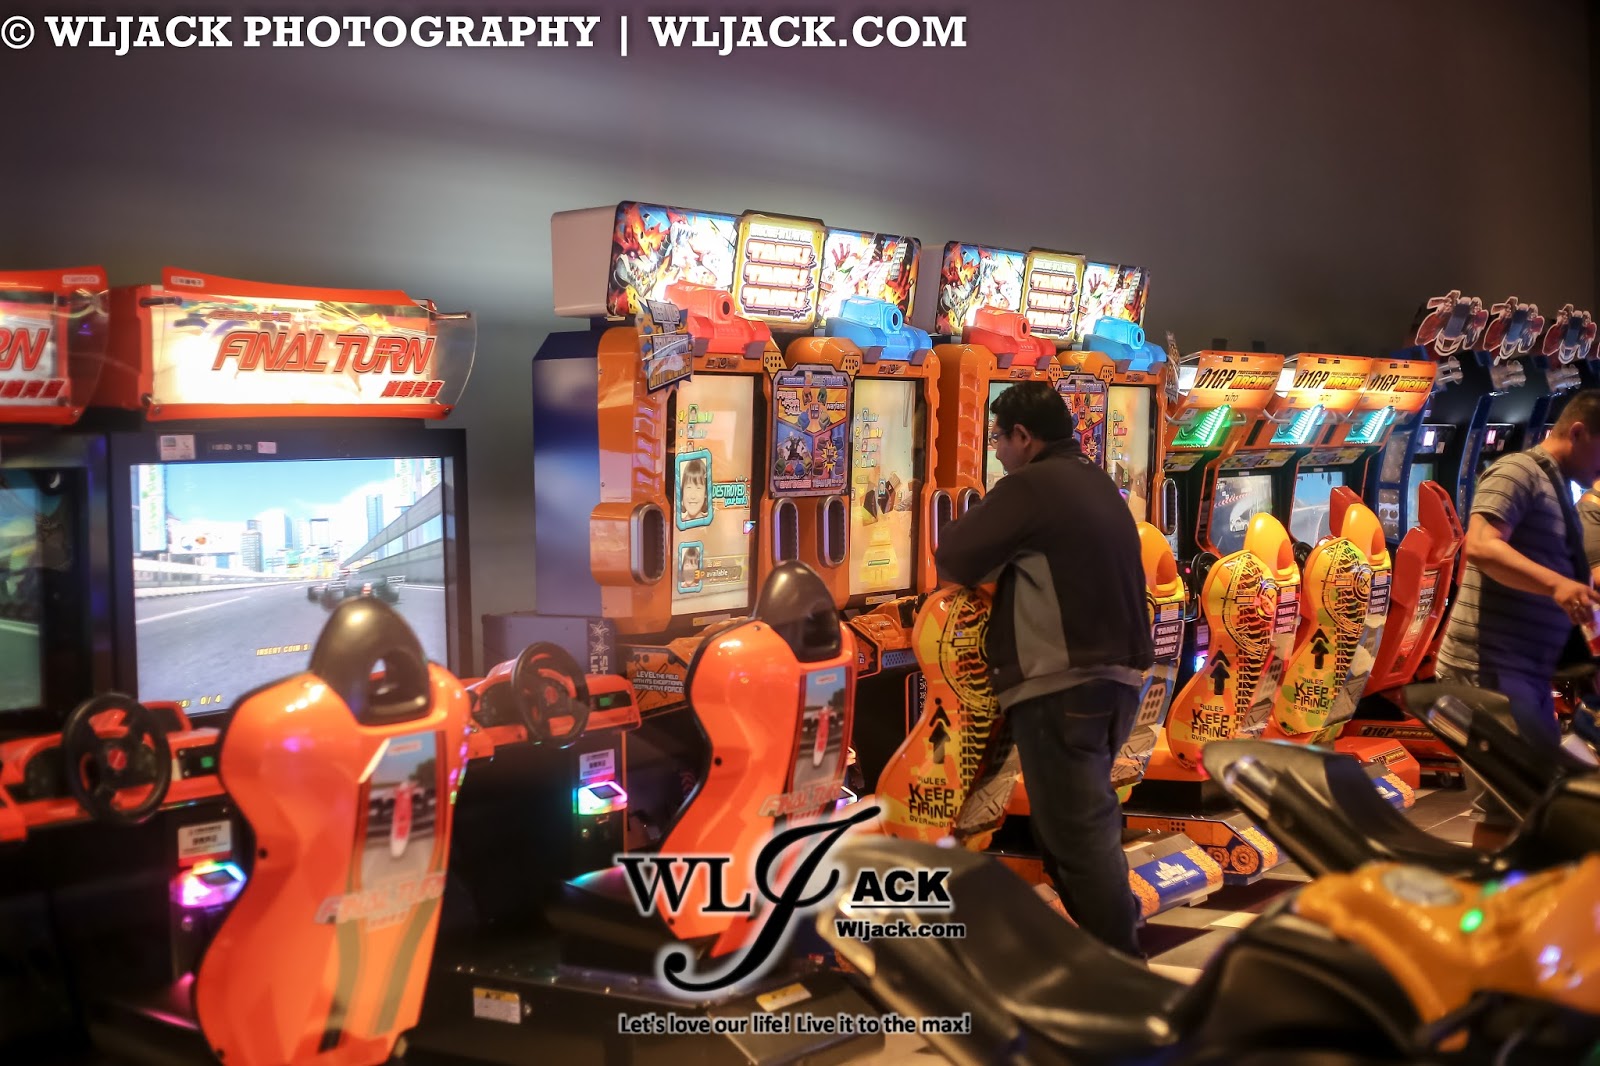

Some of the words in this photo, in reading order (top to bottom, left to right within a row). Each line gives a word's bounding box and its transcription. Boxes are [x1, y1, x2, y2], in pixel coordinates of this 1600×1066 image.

[211, 331, 329, 372] FINAL
[333, 335, 436, 375] TURN
[712, 483, 745, 498] DESTROYED
[706, 569, 729, 578] available
[636, 671, 656, 679] LEVEL
[1295, 682, 1328, 698] KEEP
[1294, 693, 1330, 709] FIRING!
[1192, 709, 1230, 726] KEEP
[1191, 721, 1231, 739] FIRING!
[909, 783, 955, 804] KEEP
